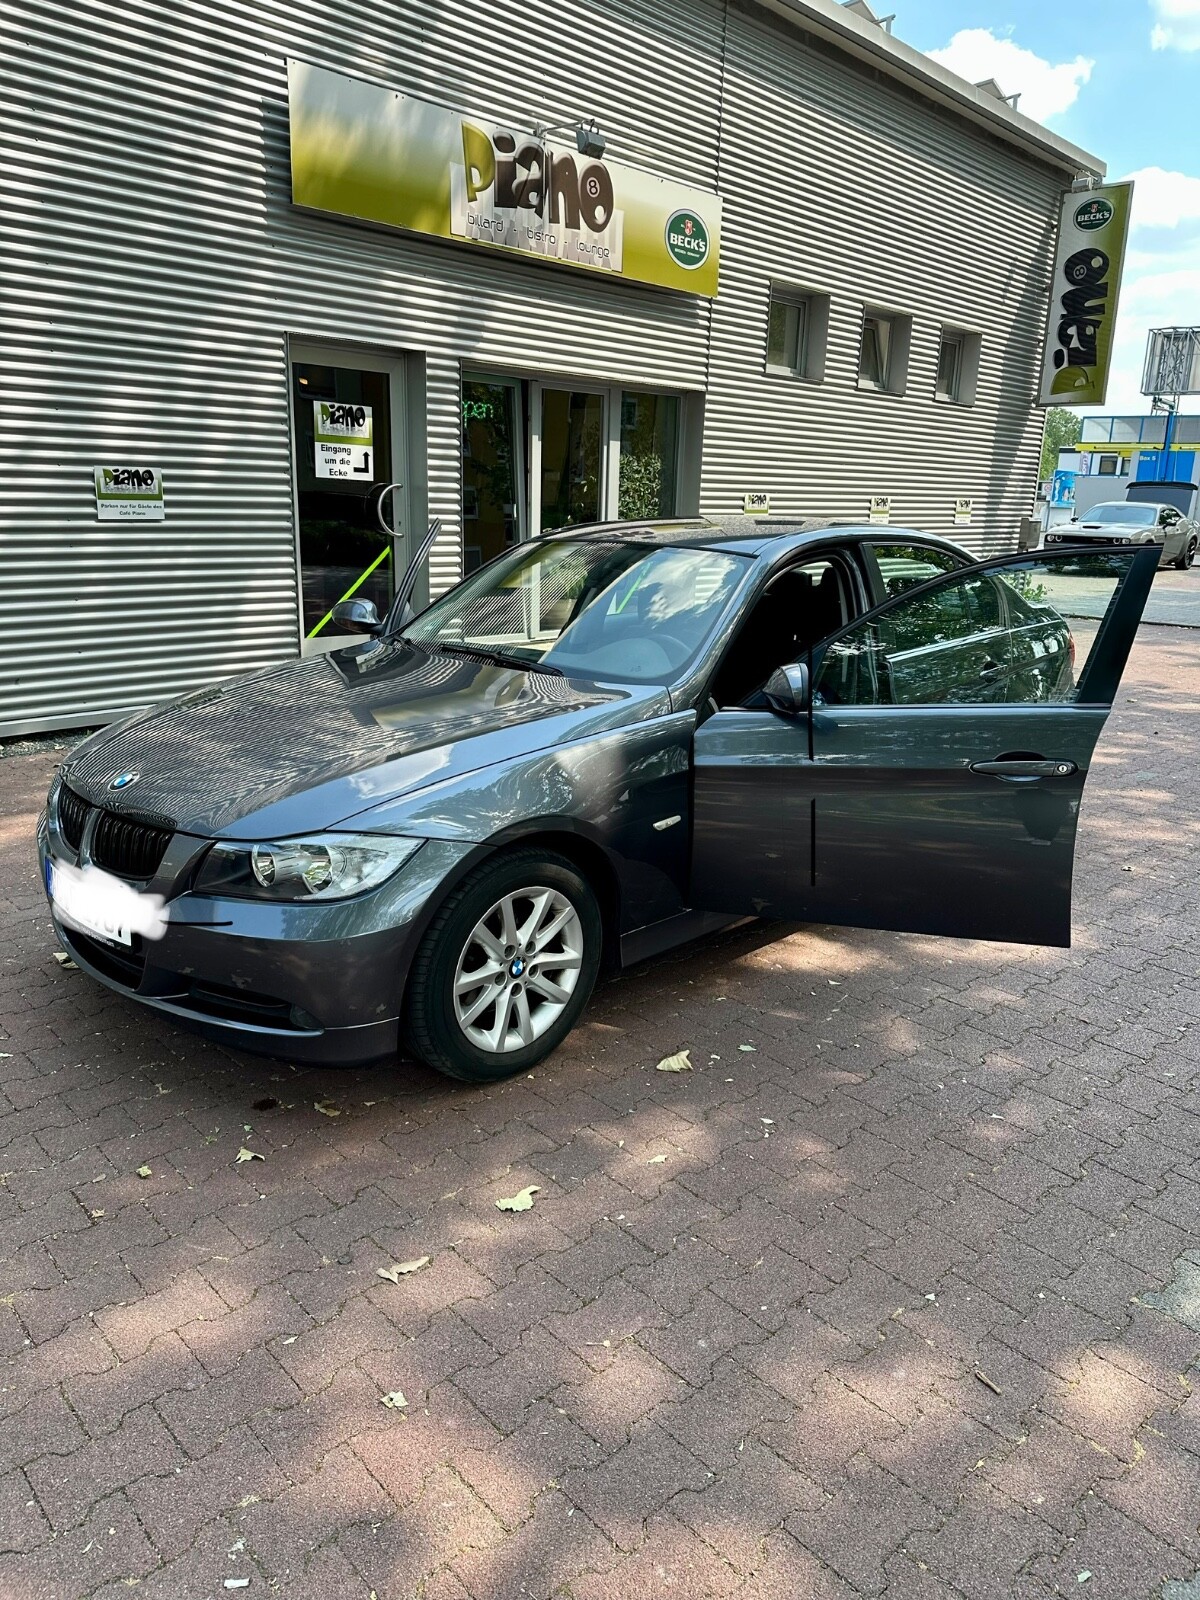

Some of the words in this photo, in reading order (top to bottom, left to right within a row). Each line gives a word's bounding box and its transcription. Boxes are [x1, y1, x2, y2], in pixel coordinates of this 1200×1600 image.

[1077, 211, 1110, 222] BECK'S
[467, 212, 504, 232] billard
[526, 226, 556, 245] bistro
[576, 239, 610, 258] lounge
[669, 232, 706, 253] BECK'S
[320, 444, 352, 456] Eingang
[339, 458, 351, 466] die
[329, 468, 348, 477] Ecke
